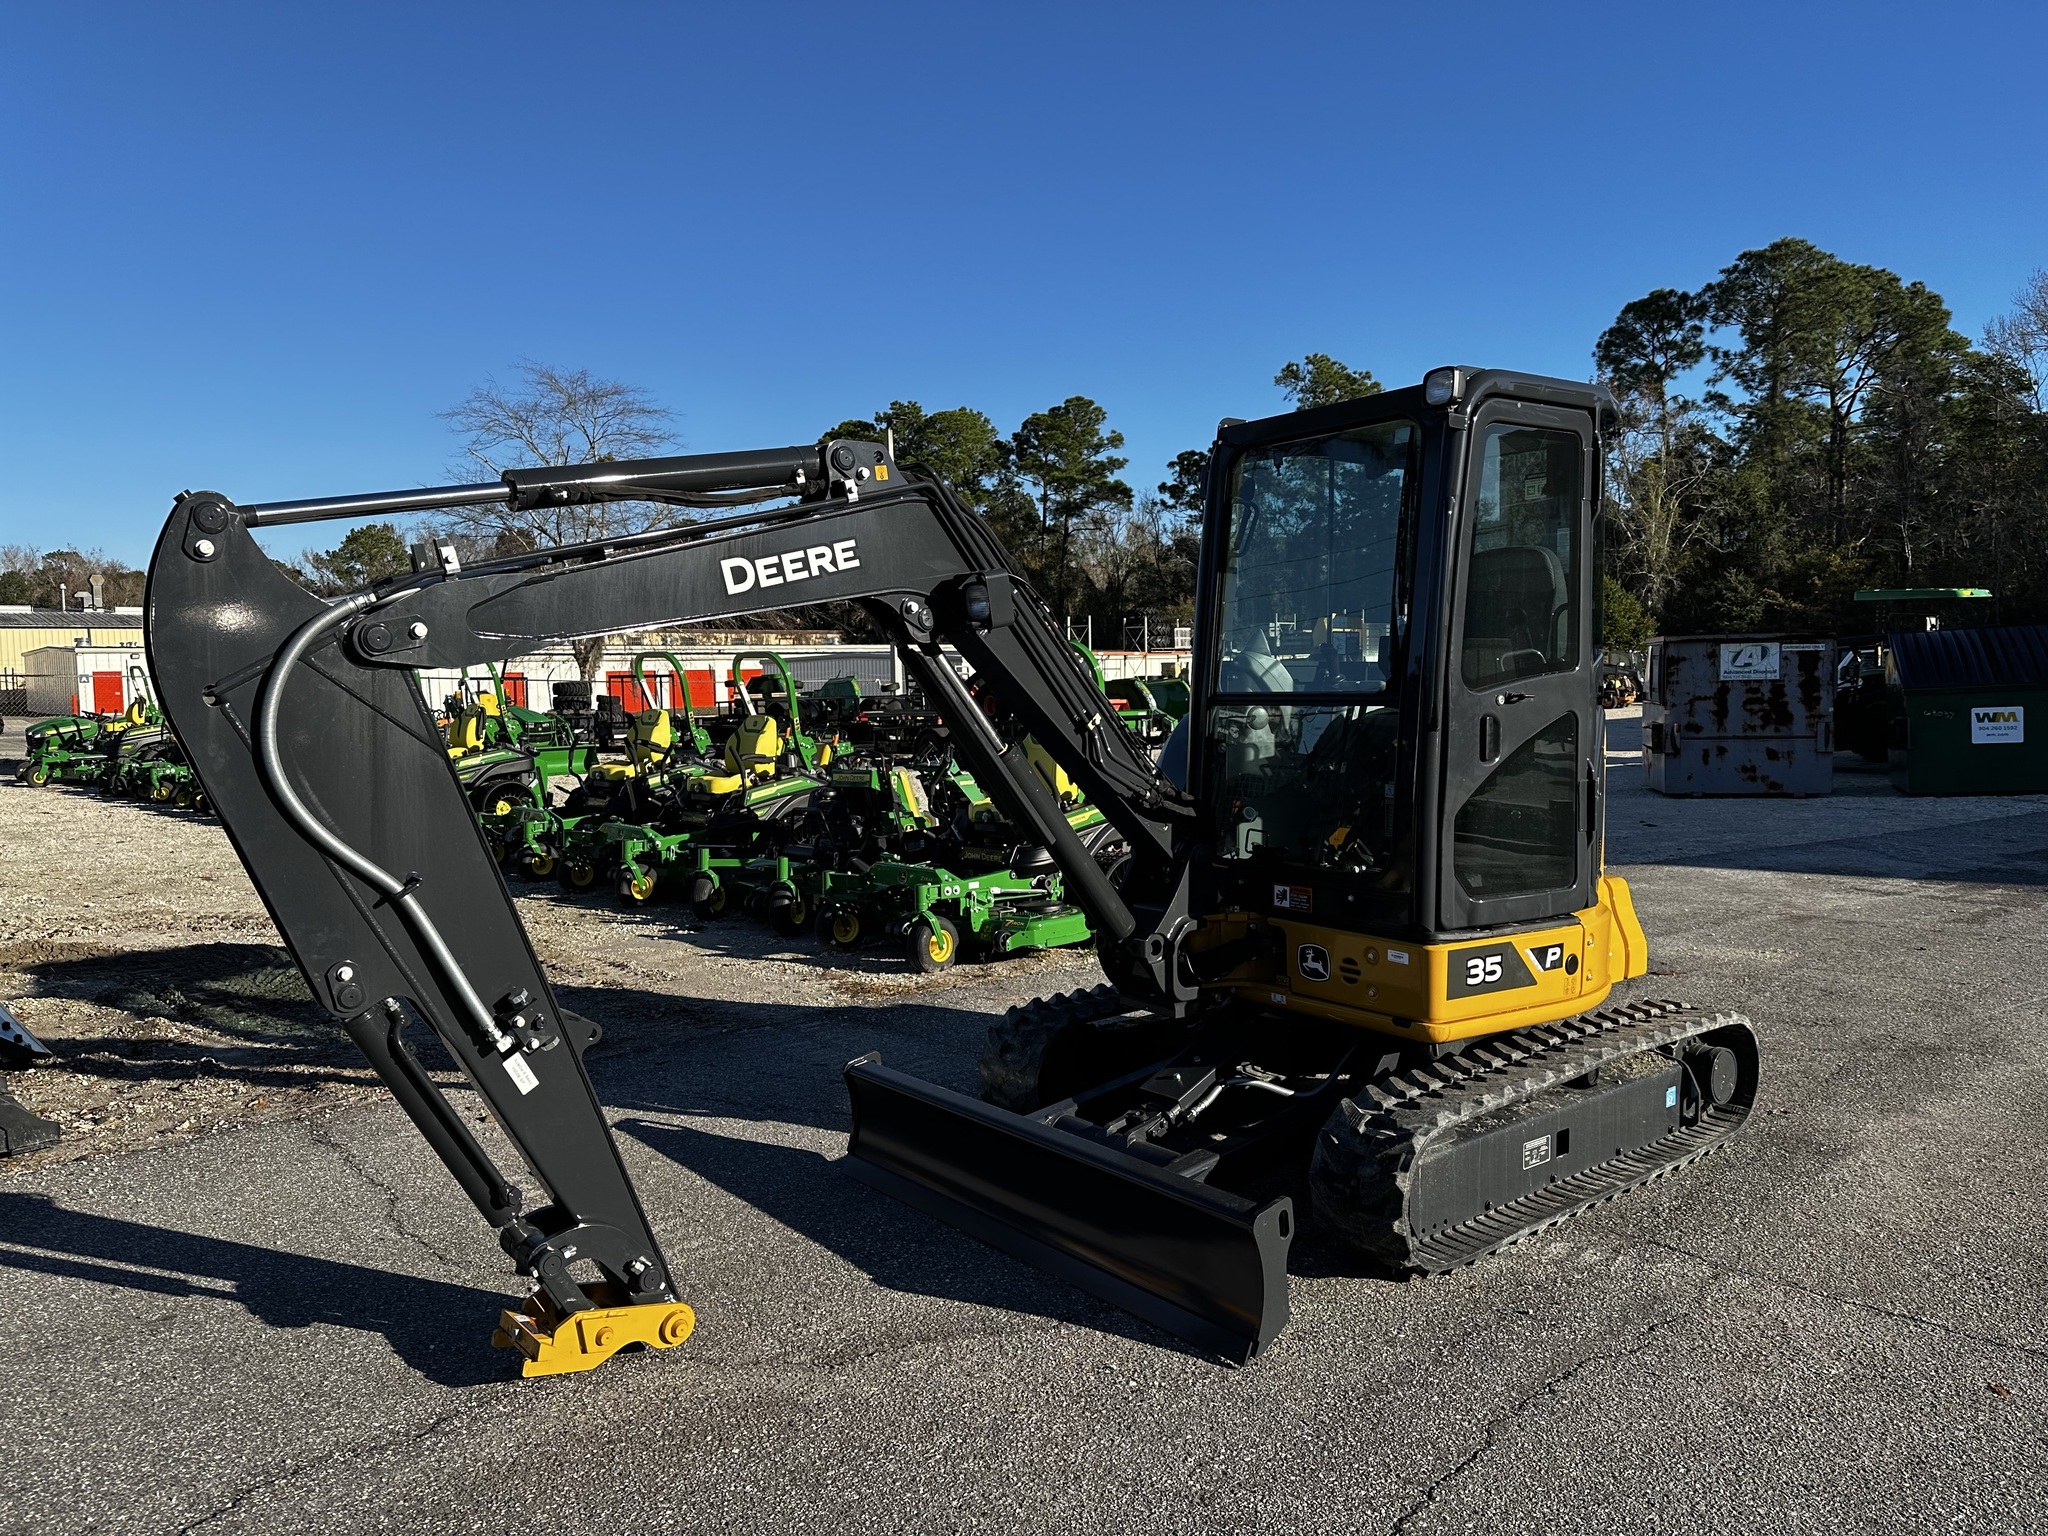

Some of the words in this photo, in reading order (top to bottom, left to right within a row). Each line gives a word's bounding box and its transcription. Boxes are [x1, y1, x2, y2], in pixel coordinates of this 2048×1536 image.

[720, 539, 861, 596] DEERE
[1974, 711, 2019, 723] WM
[963, 851, 981, 860] JOHN
[981, 852, 1003, 863] DEERE
[1545, 946, 1562, 969] P
[1466, 954, 1503, 986] 35
